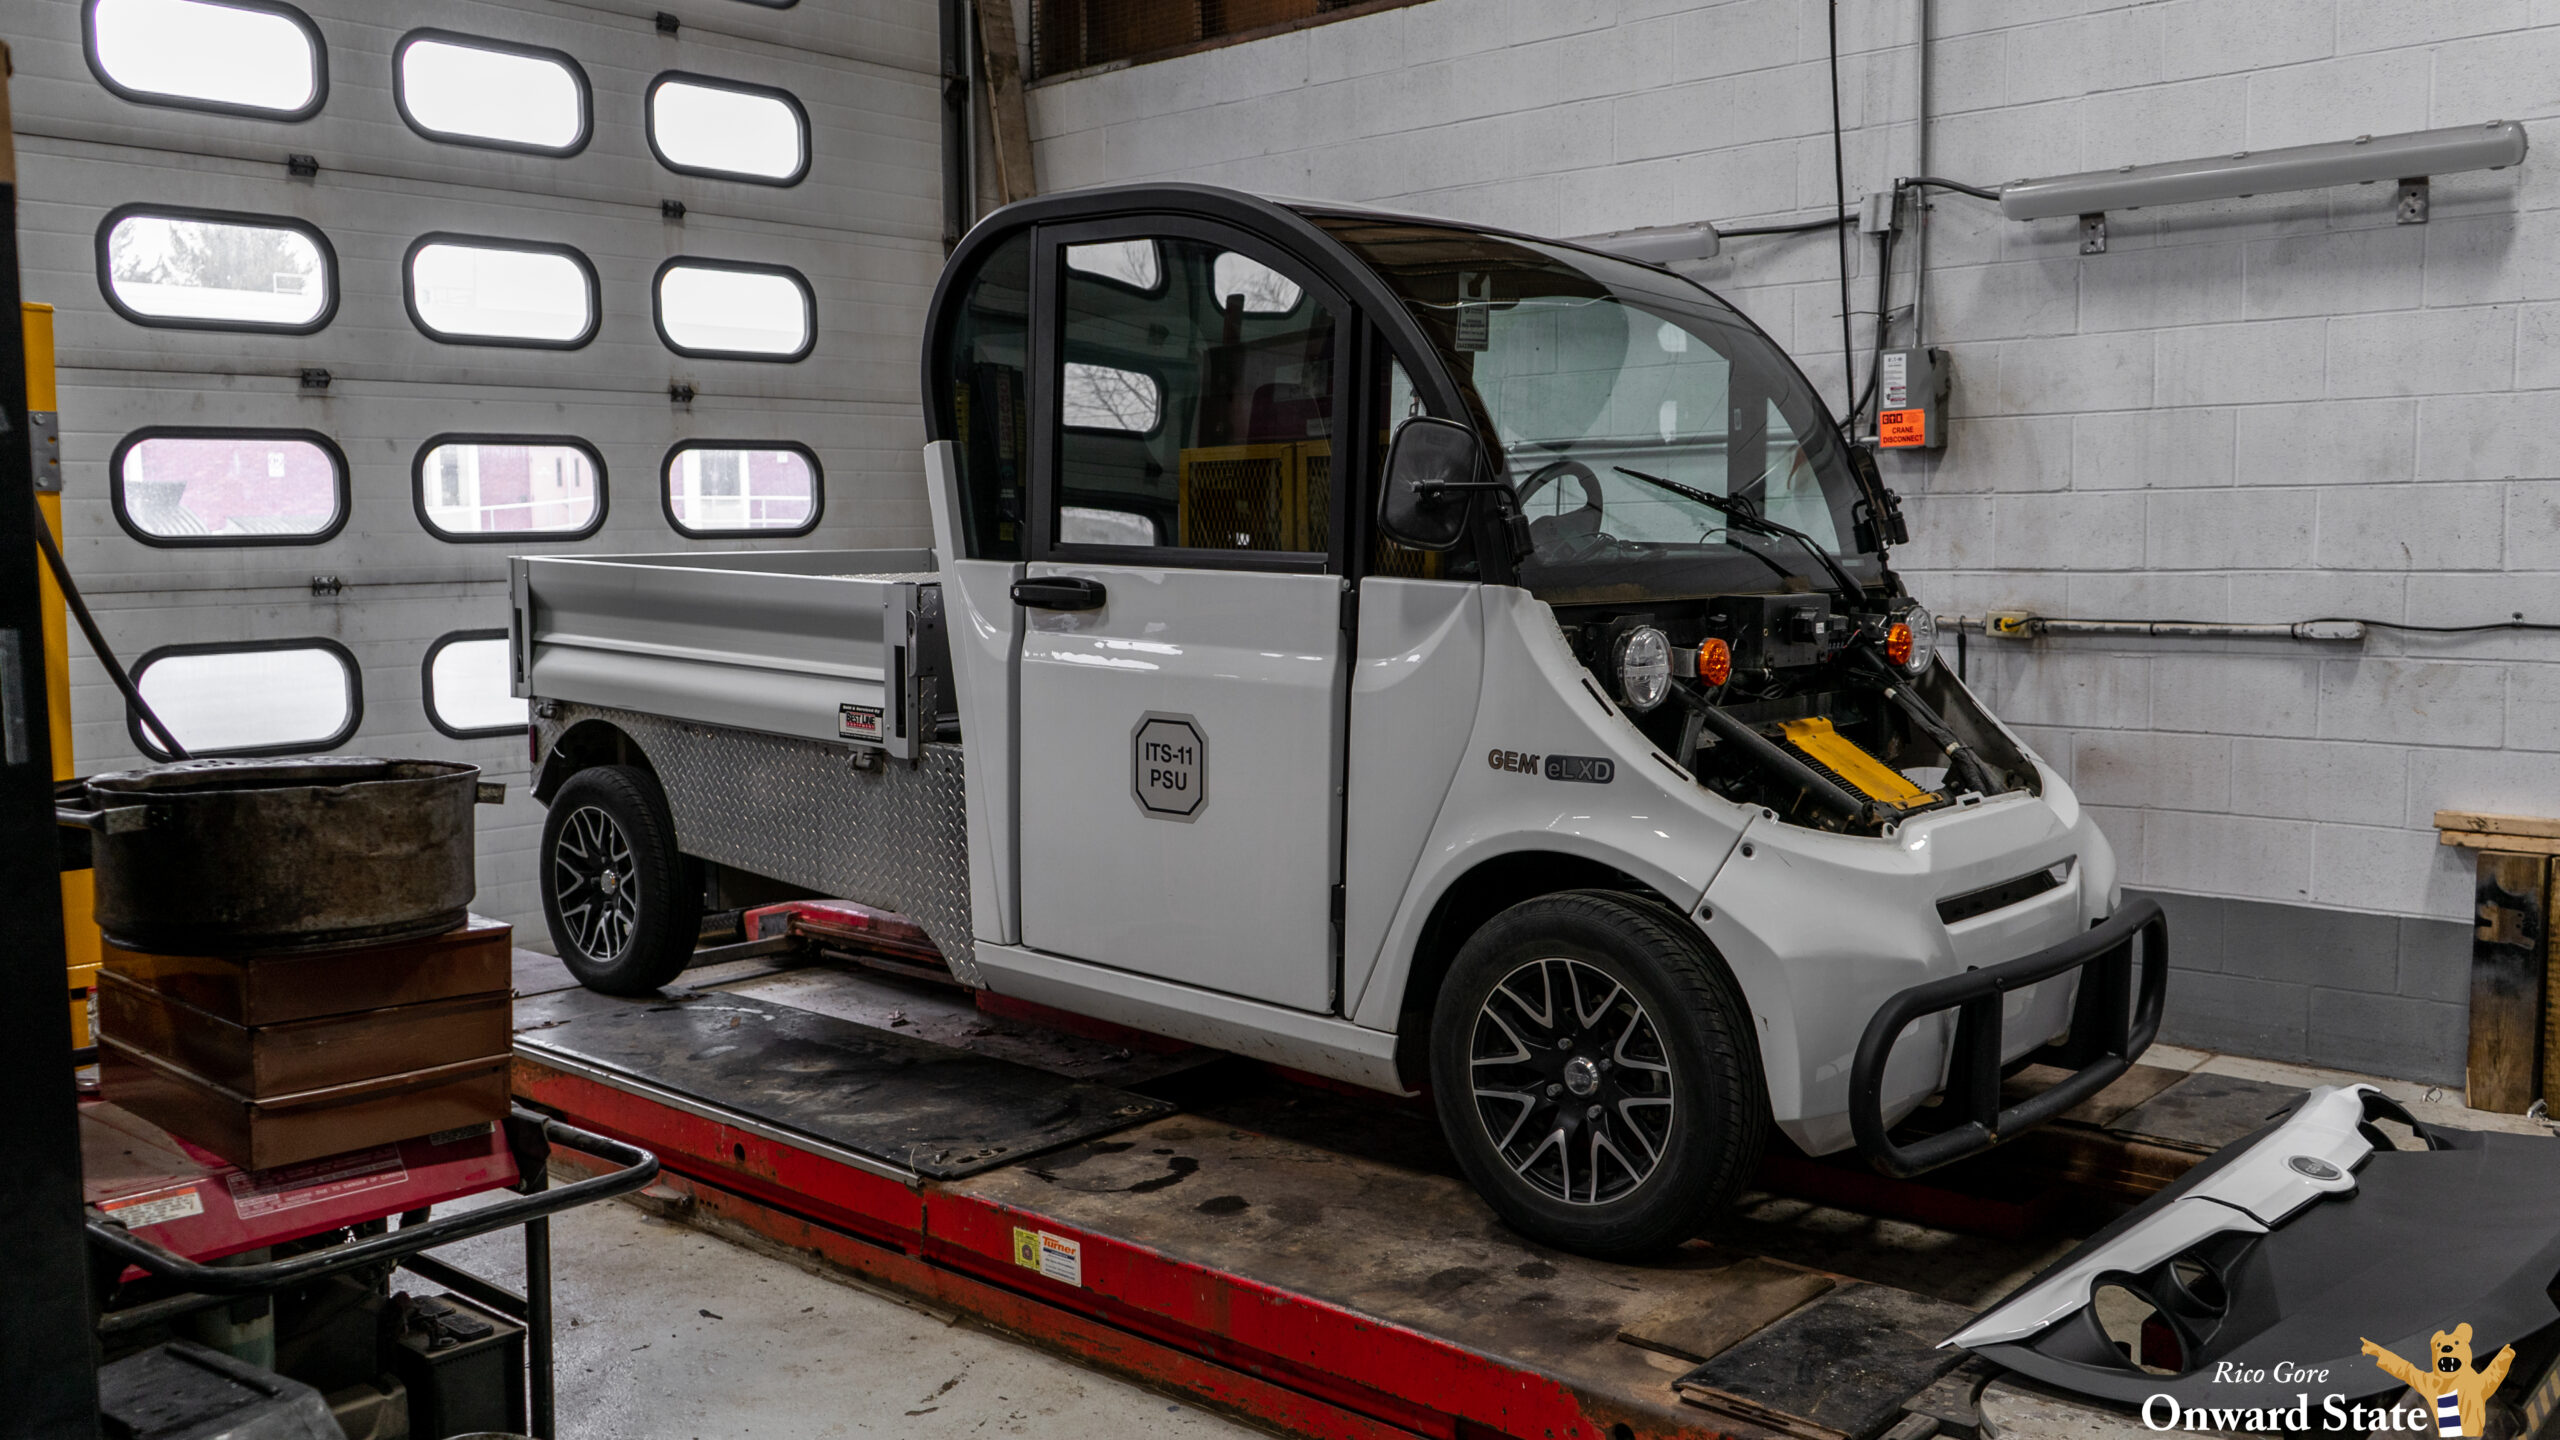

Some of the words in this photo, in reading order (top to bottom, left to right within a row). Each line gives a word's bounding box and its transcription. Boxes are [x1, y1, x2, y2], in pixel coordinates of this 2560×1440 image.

[1883, 434, 1923, 444] DISCONNECT
[1892, 426, 1914, 434] CRANE
[846, 712, 861, 722] BEST
[862, 713, 876, 724] LINE
[1145, 742, 1192, 765] ITS-11
[1488, 748, 1539, 775] GEM
[1547, 759, 1611, 781] eLXD
[1150, 769, 1187, 791] PSU
[1042, 1235, 1077, 1255] Turner
